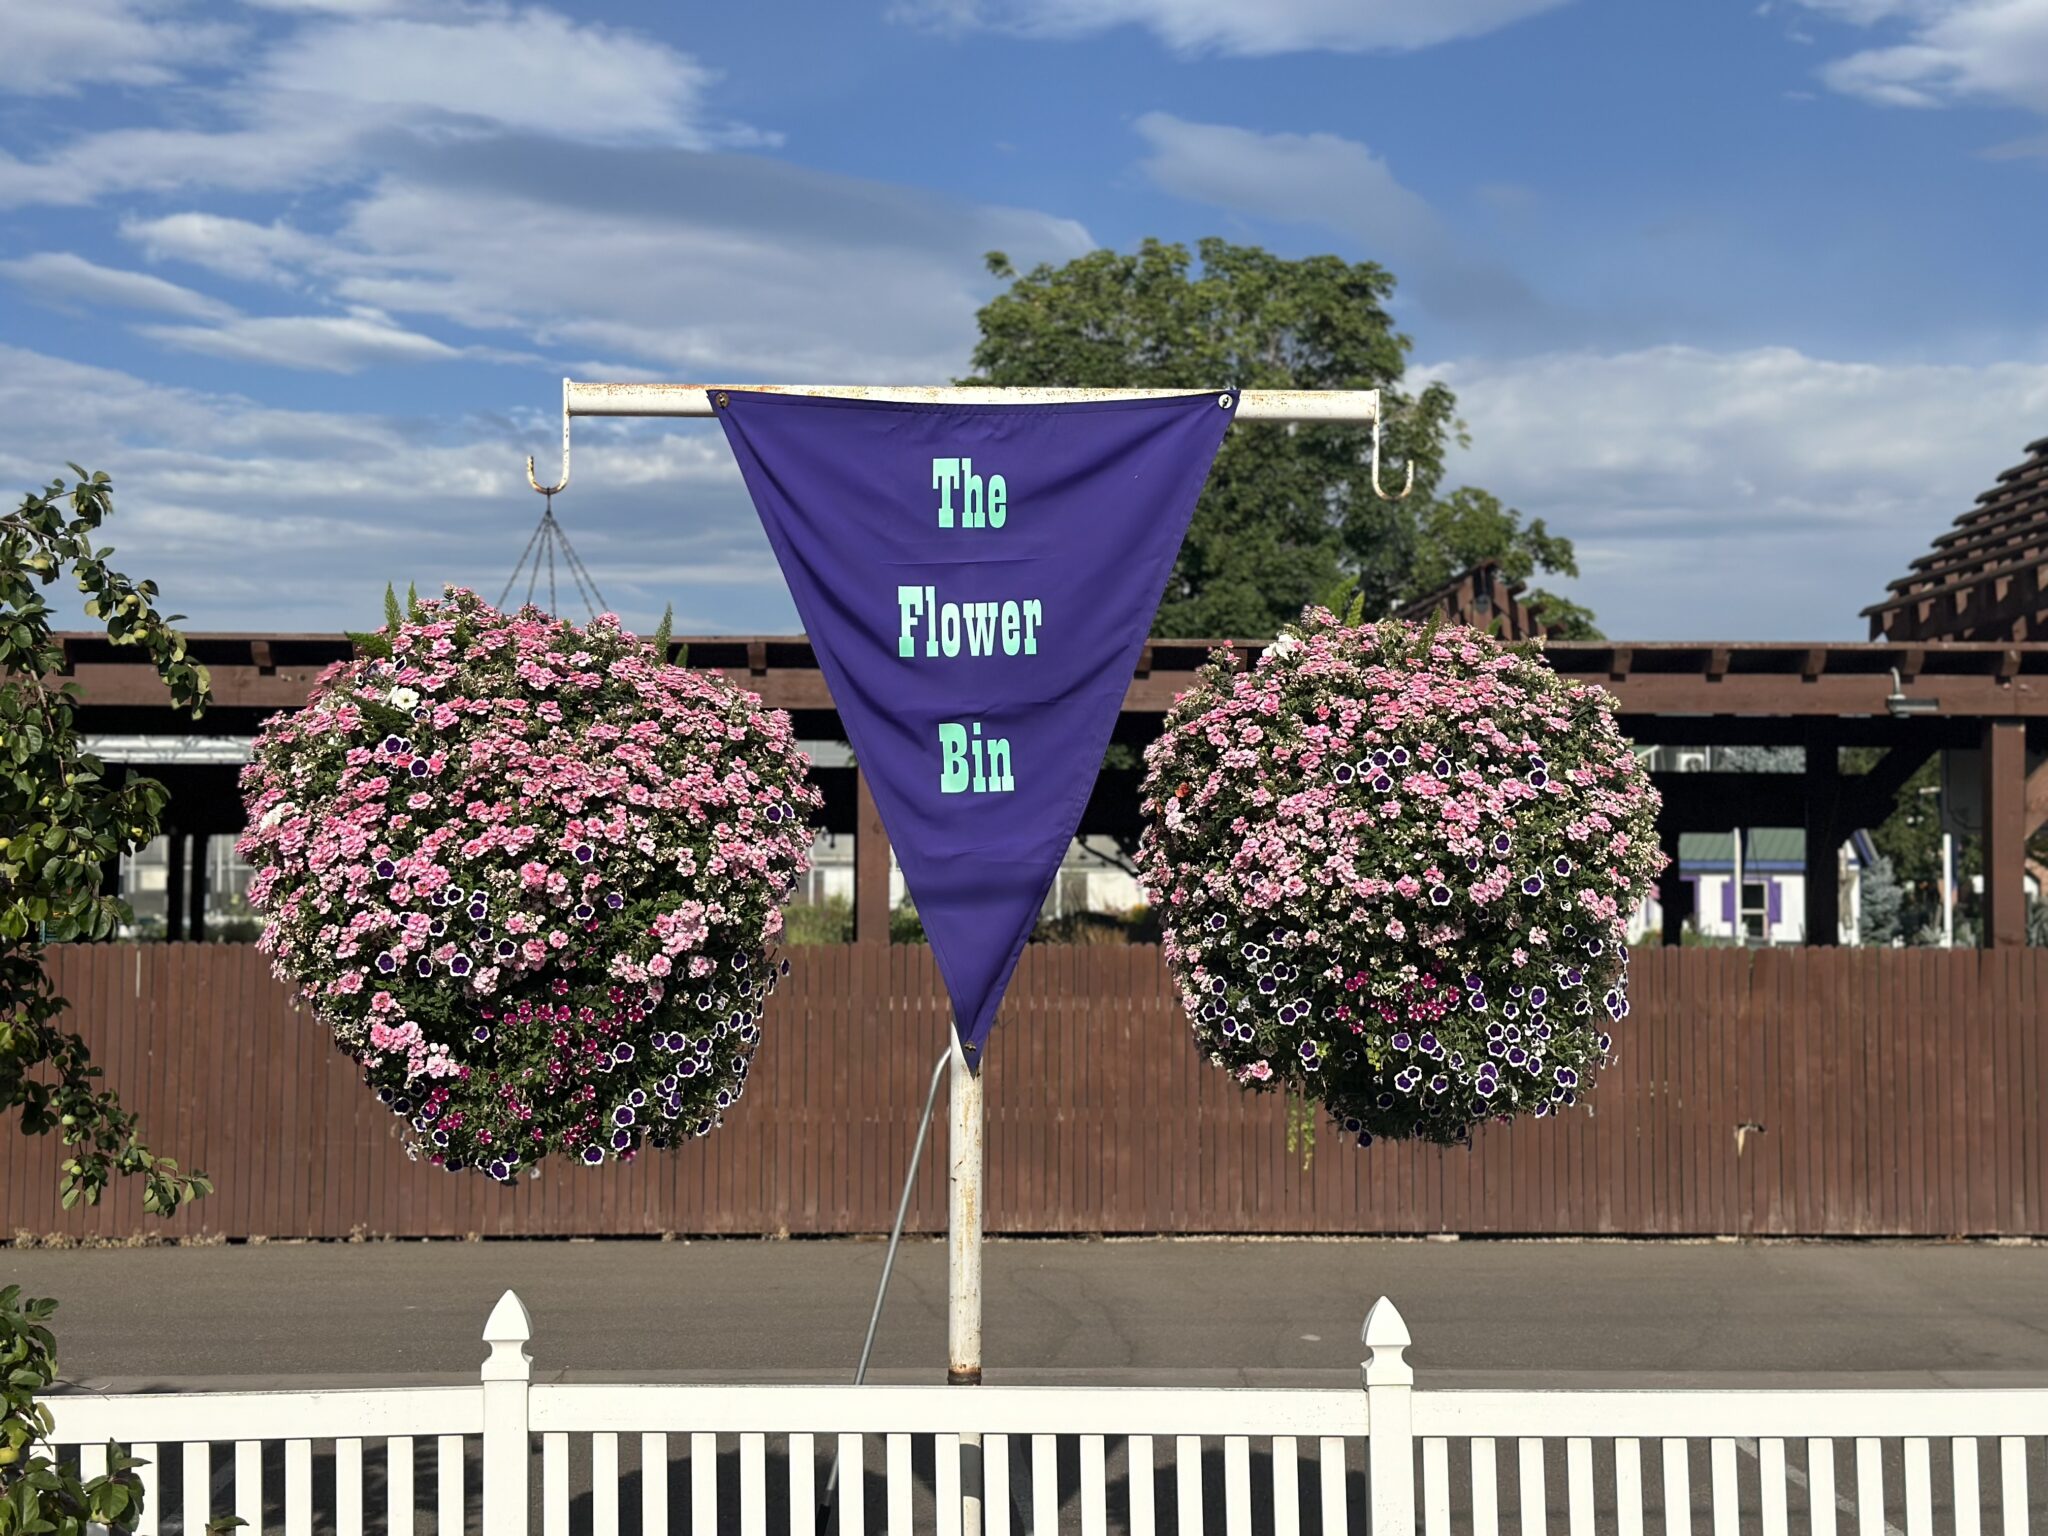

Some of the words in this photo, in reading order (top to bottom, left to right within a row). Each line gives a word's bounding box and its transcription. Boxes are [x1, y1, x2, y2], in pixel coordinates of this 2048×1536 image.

[932, 457, 1008, 529] The
[897, 585, 1042, 658] Flower
[938, 722, 1015, 794] Bin
